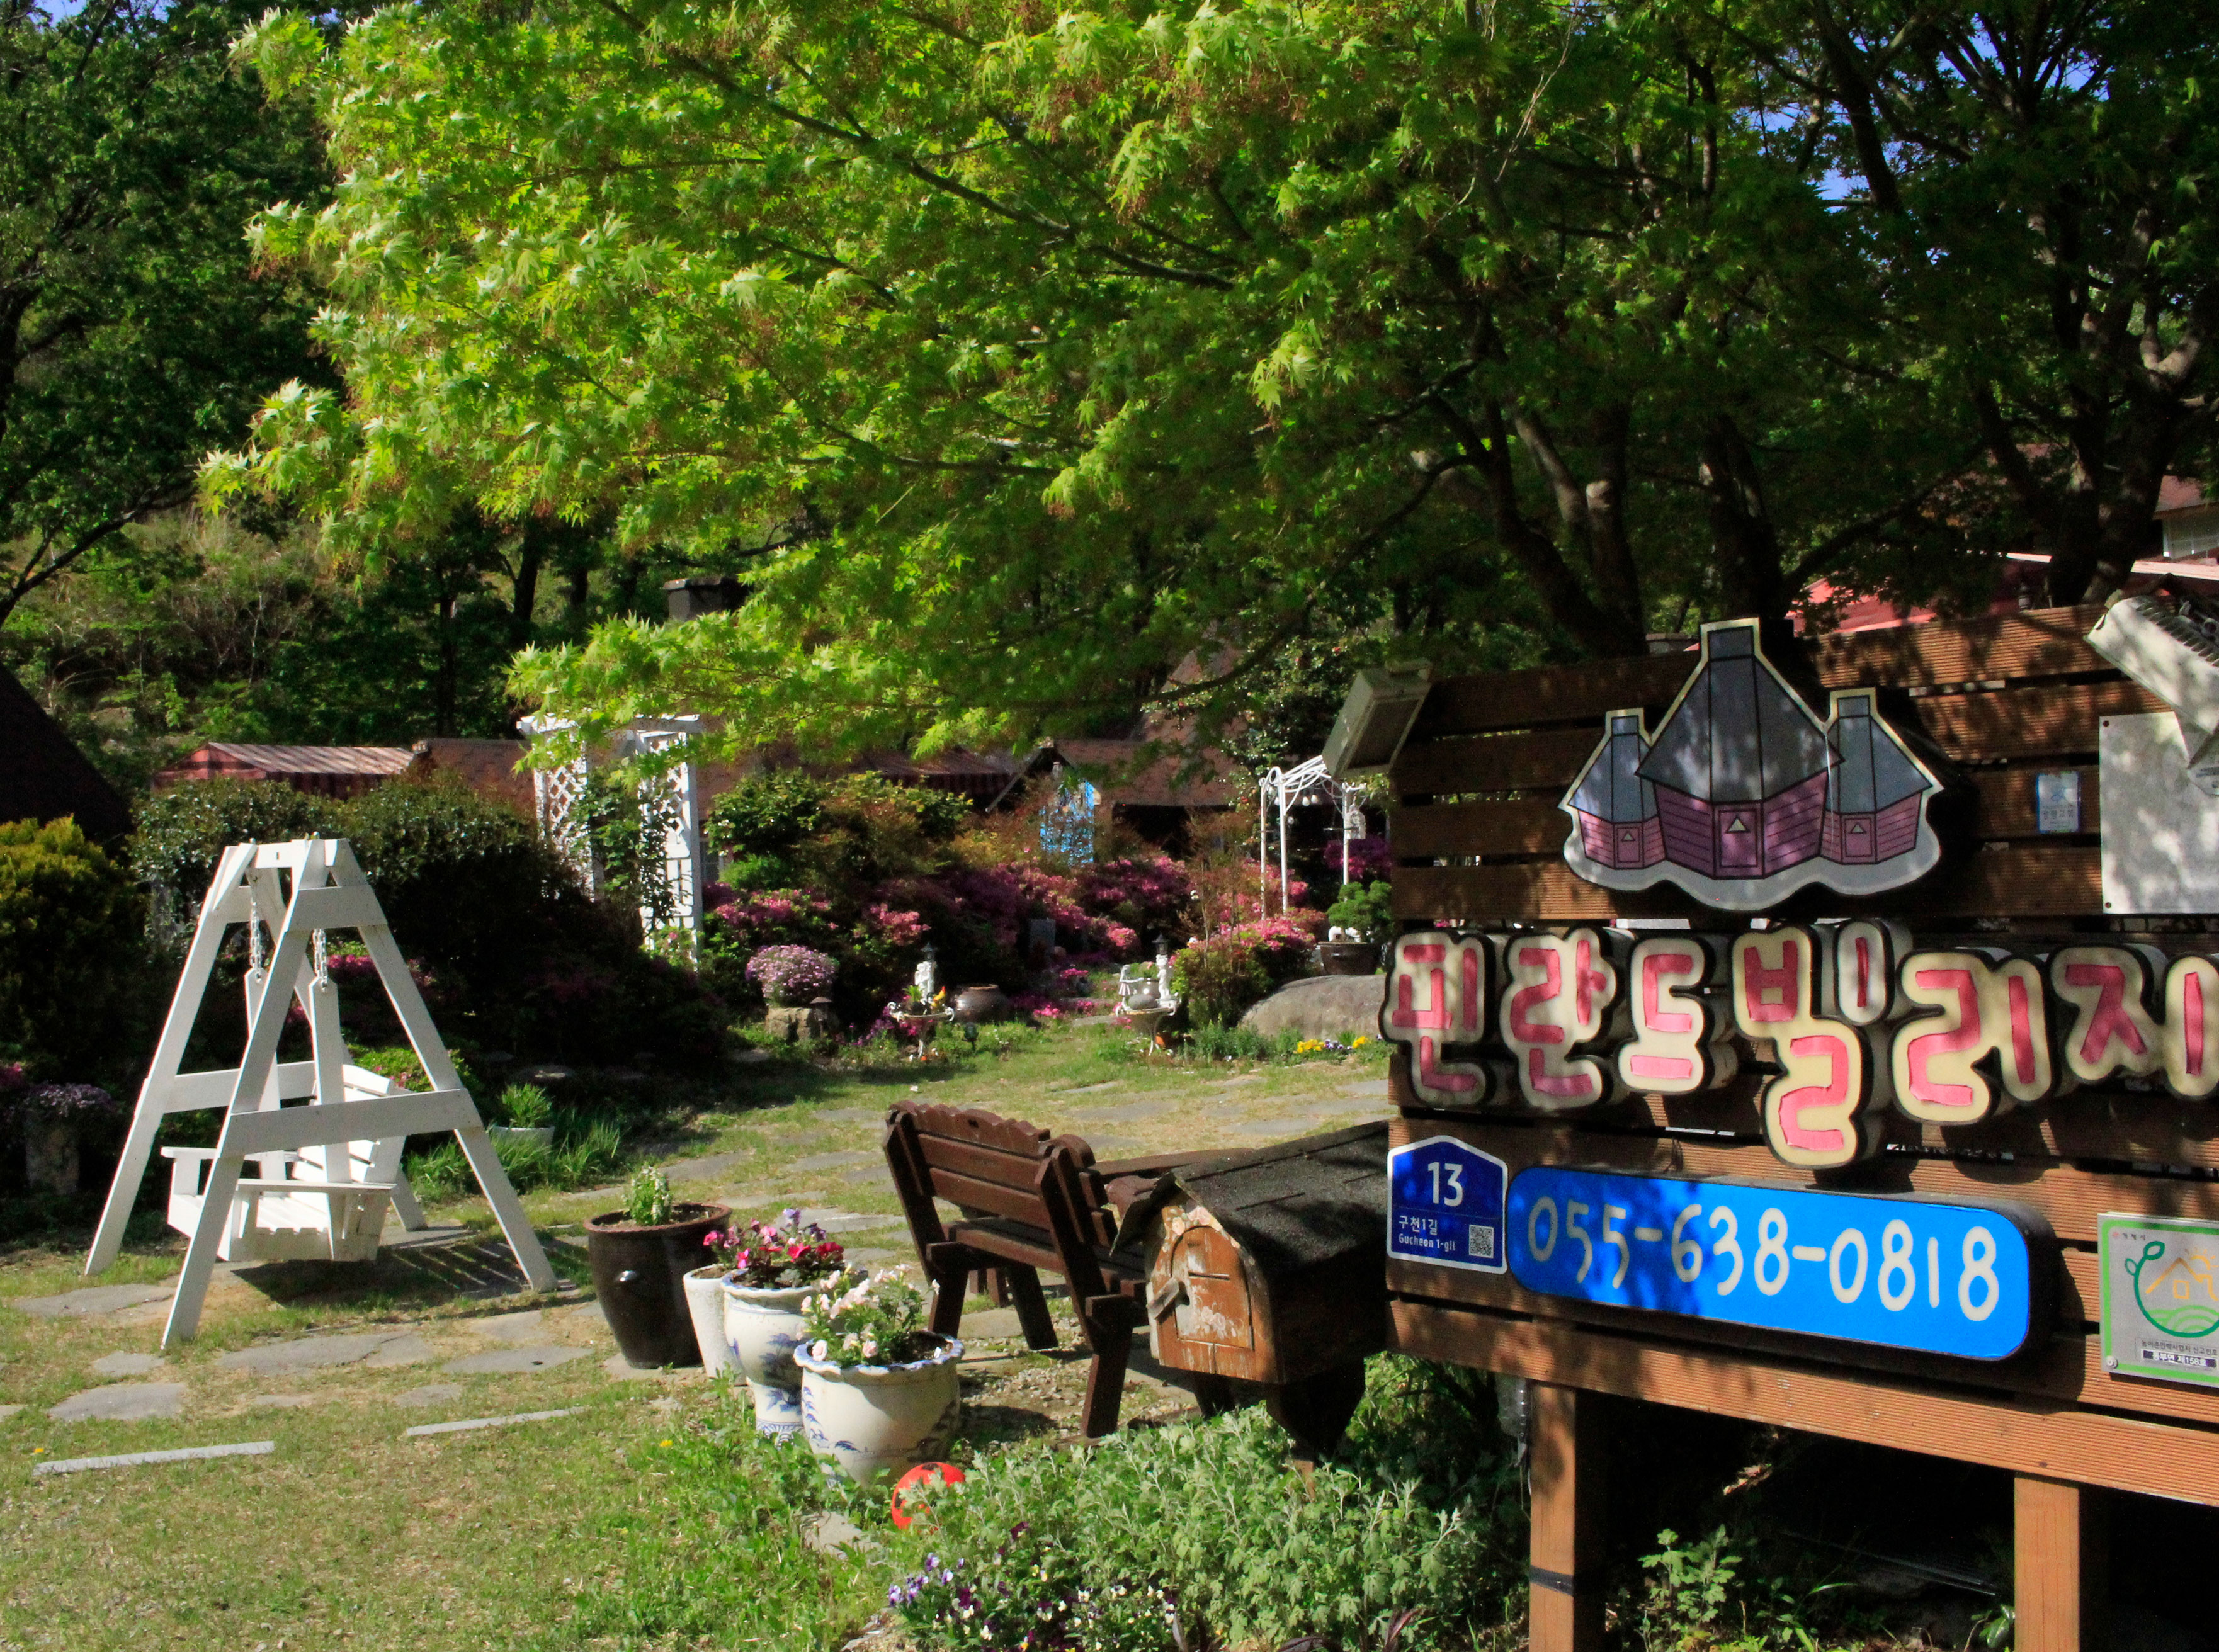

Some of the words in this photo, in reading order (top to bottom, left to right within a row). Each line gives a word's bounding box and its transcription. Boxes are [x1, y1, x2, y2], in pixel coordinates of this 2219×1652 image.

[1427, 1162, 1464, 1207] 13
[1399, 1215, 1438, 1235] 구천1길
[1399, 1233, 1434, 1248] Gucheon
[1436, 1239, 1456, 1252] 1-gil
[1528, 1195, 2000, 1322] 055-638-0818
